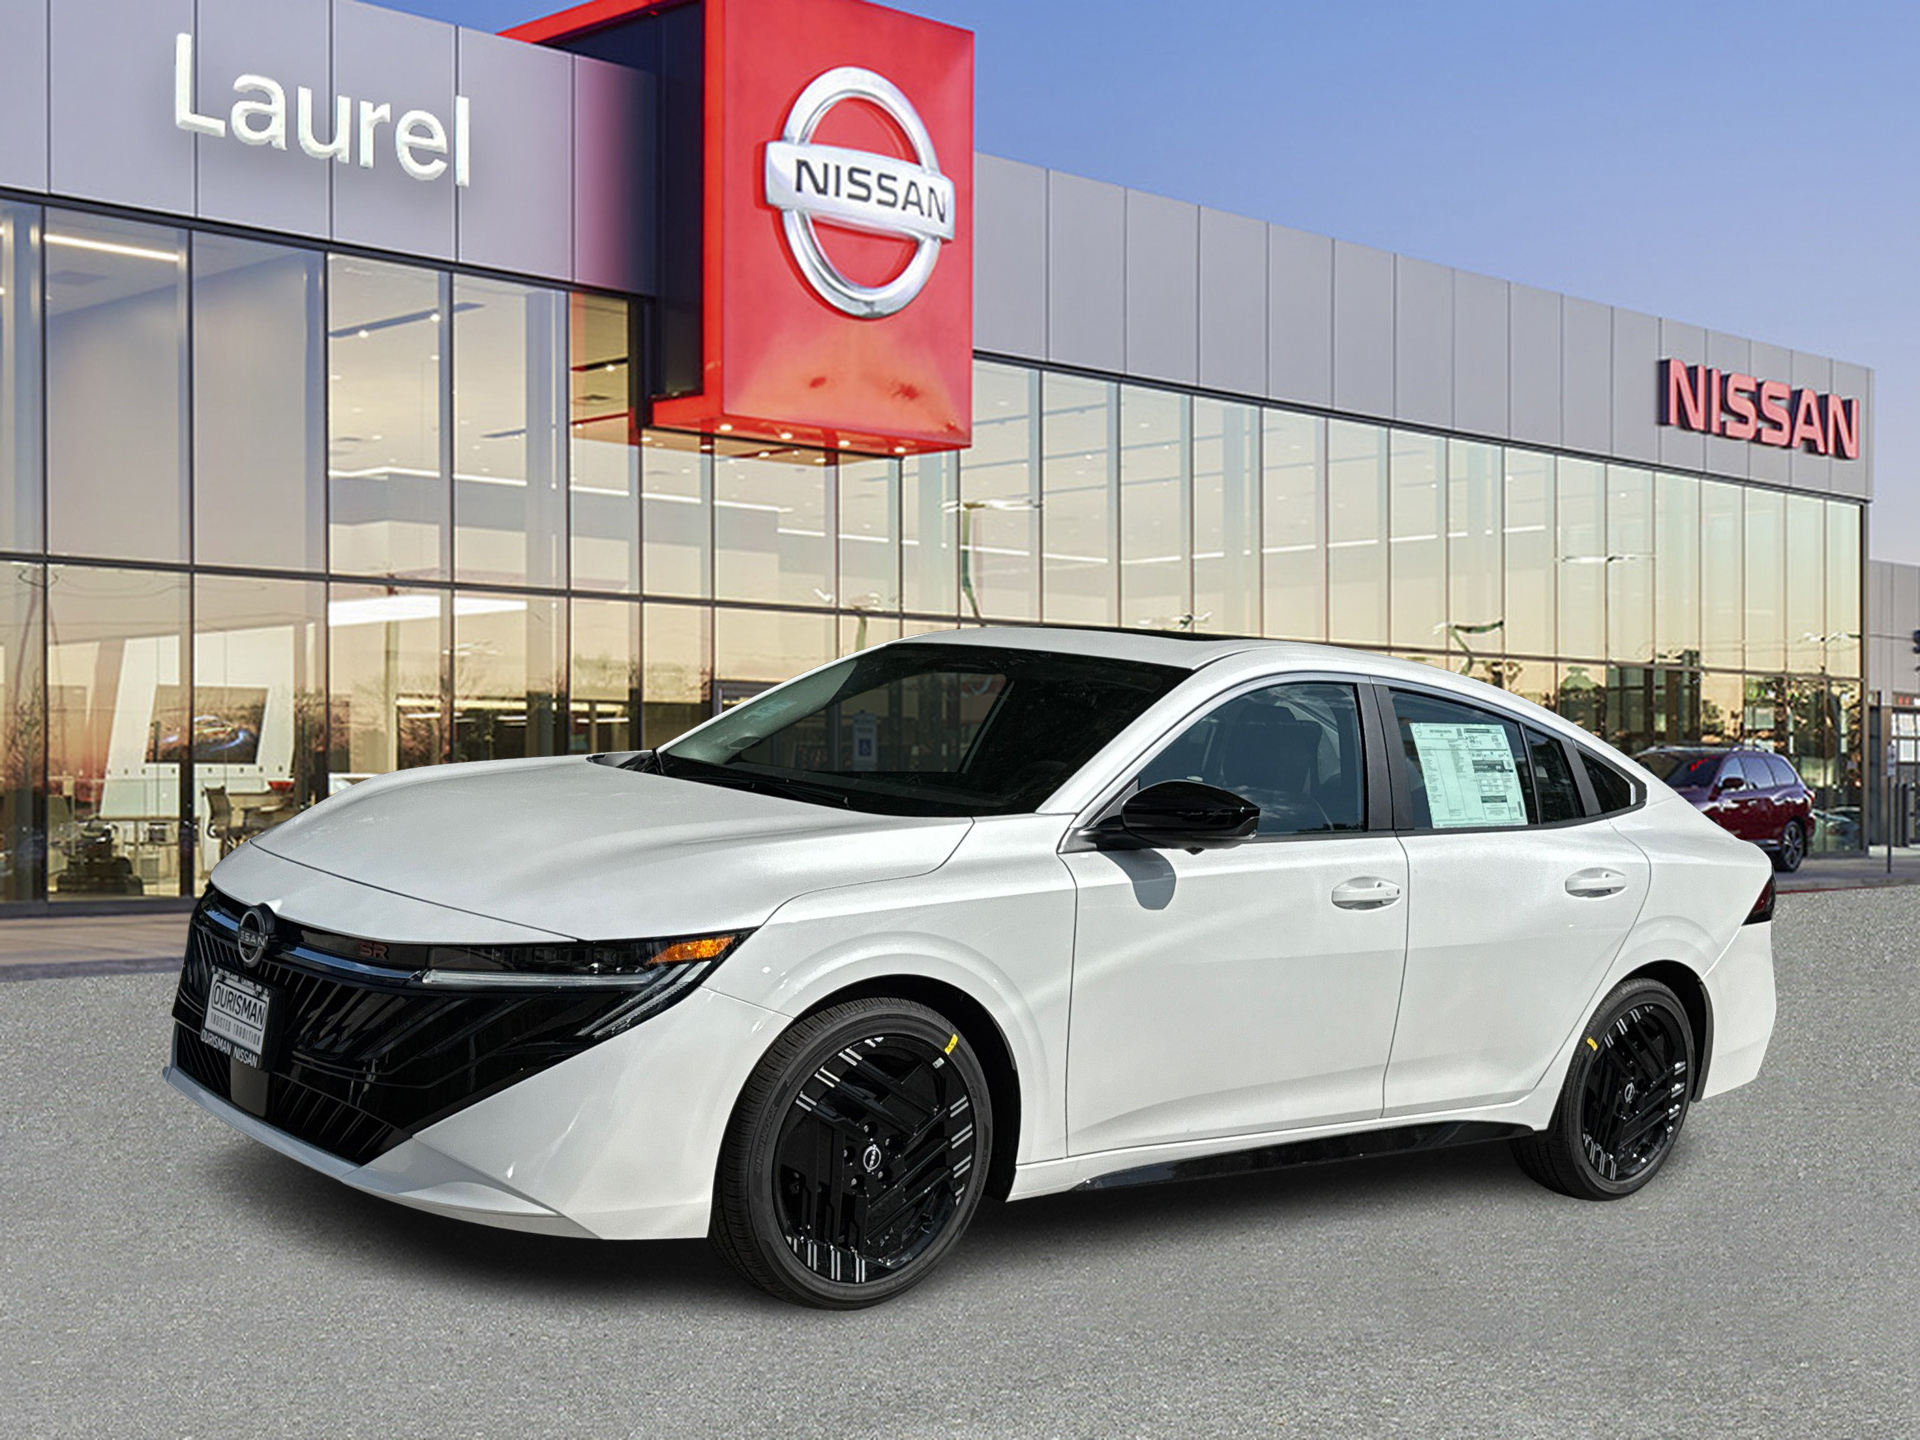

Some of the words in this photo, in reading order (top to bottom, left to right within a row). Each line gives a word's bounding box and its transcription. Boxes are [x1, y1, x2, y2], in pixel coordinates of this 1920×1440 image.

[175, 33, 470, 187] Laurel
[794, 158, 947, 224] NISSAN
[1660, 358, 1860, 460] NISSAN
[359, 941, 388, 960] SR
[213, 984, 265, 1027] OURISMAN
[200, 1028, 232, 1056] OURISMAN
[232, 1045, 258, 1069] NISSAN
